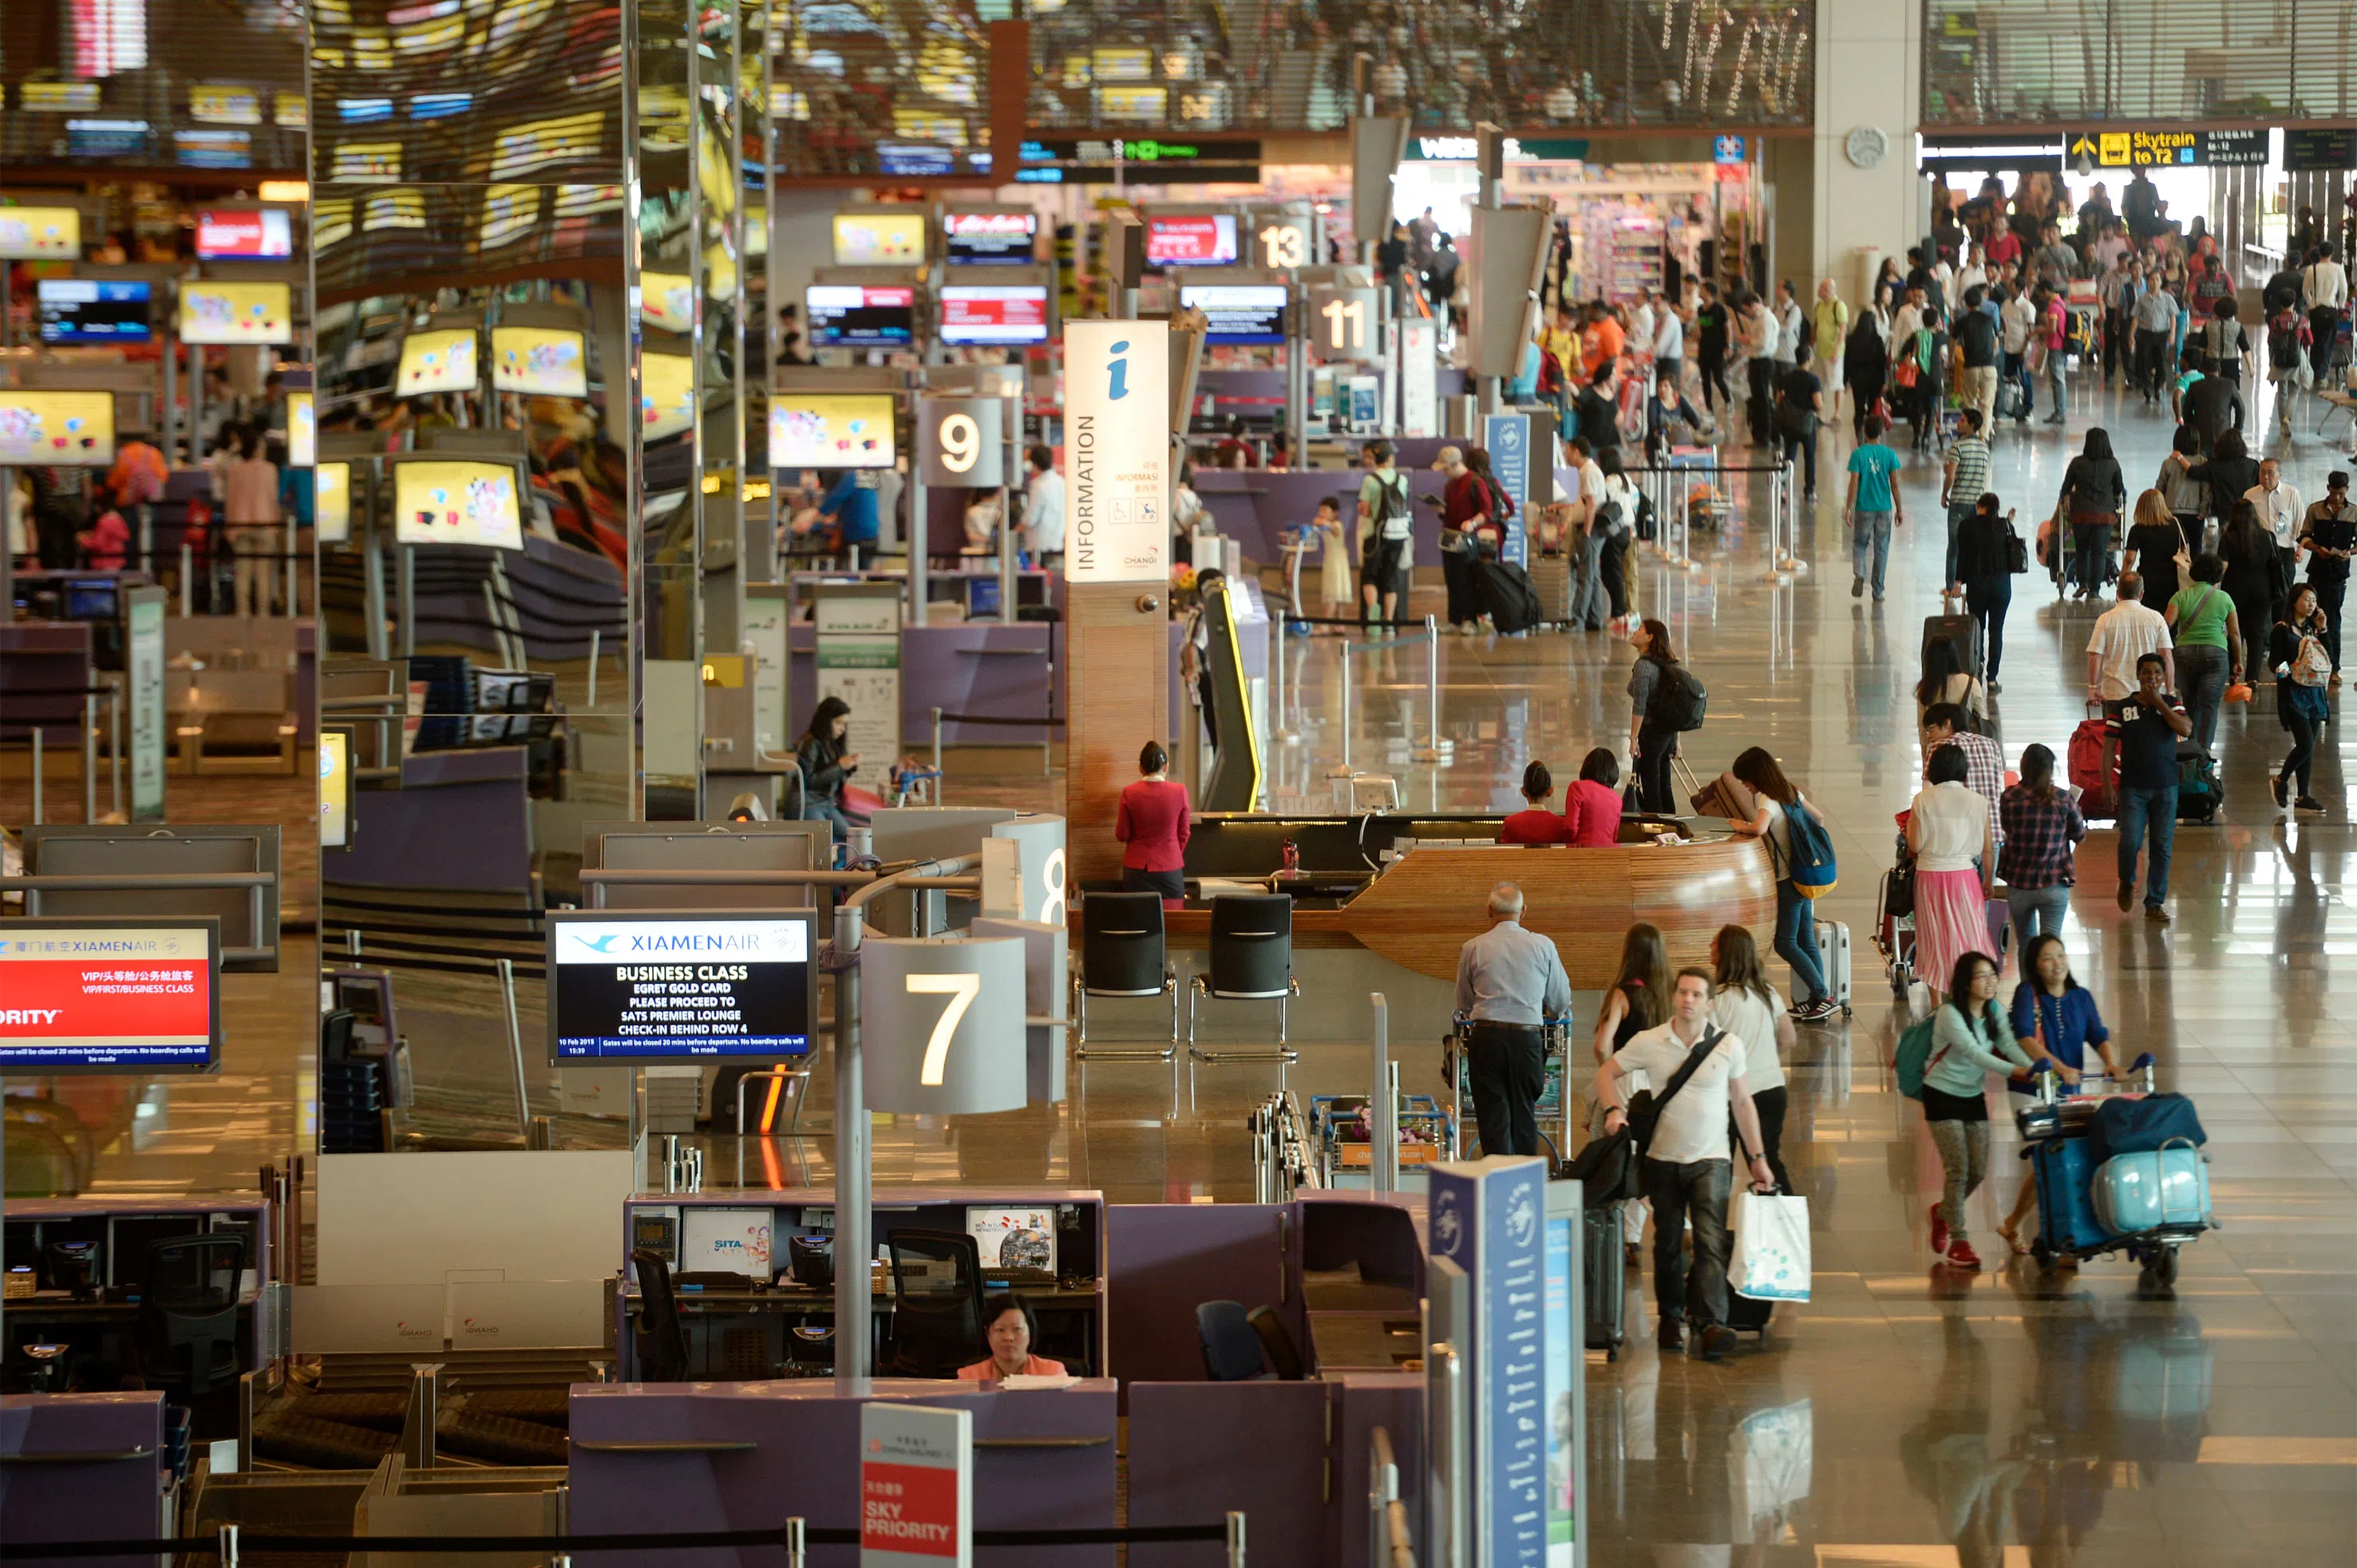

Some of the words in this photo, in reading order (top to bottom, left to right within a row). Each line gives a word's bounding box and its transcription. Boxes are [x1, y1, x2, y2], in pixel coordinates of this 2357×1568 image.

[2134, 131, 2194, 152] Skytrain
[2134, 150, 2151, 164] to
[2155, 149, 2172, 164] T2
[1260, 225, 1304, 269] 13
[1322, 299, 1364, 349] 11
[939, 413, 979, 473] 9
[1078, 416, 1093, 571] INFORMATION
[2123, 706, 2139, 722] 81
[1041, 847, 1066, 924] 8
[73, 941, 157, 951] XIAMENAIR
[631, 934, 759, 950] XIAMENAIR
[617, 966, 693, 981] BUSINESS
[698, 966, 748, 980] CLASS
[82, 985, 164, 993] VIP/FIRST/BUSINESS
[634, 984, 666, 993] EGRET
[669, 983, 699, 993] GOLD
[702, 983, 731, 993] CARD
[630, 997, 667, 1008] PLEASE
[670, 997, 718, 1007] PROCEED
[720, 997, 735, 1007] TO
[621, 1011, 647, 1021] SATS
[651, 1011, 694, 1021] PREMIER
[698, 1010, 741, 1021] LOUNGE
[619, 1025, 667, 1035] CHECK-IN
[670, 1025, 710, 1034] BEHIND
[712, 1025, 738, 1034] ROW
[740, 1024, 748, 1034] 4
[906, 974, 980, 1086] 7
[708, 1038, 739, 1047] departure.
[752, 1037, 778, 1046] boarding
[865, 1500, 903, 1519] SKY
[865, 1518, 950, 1542] PRIORITY
